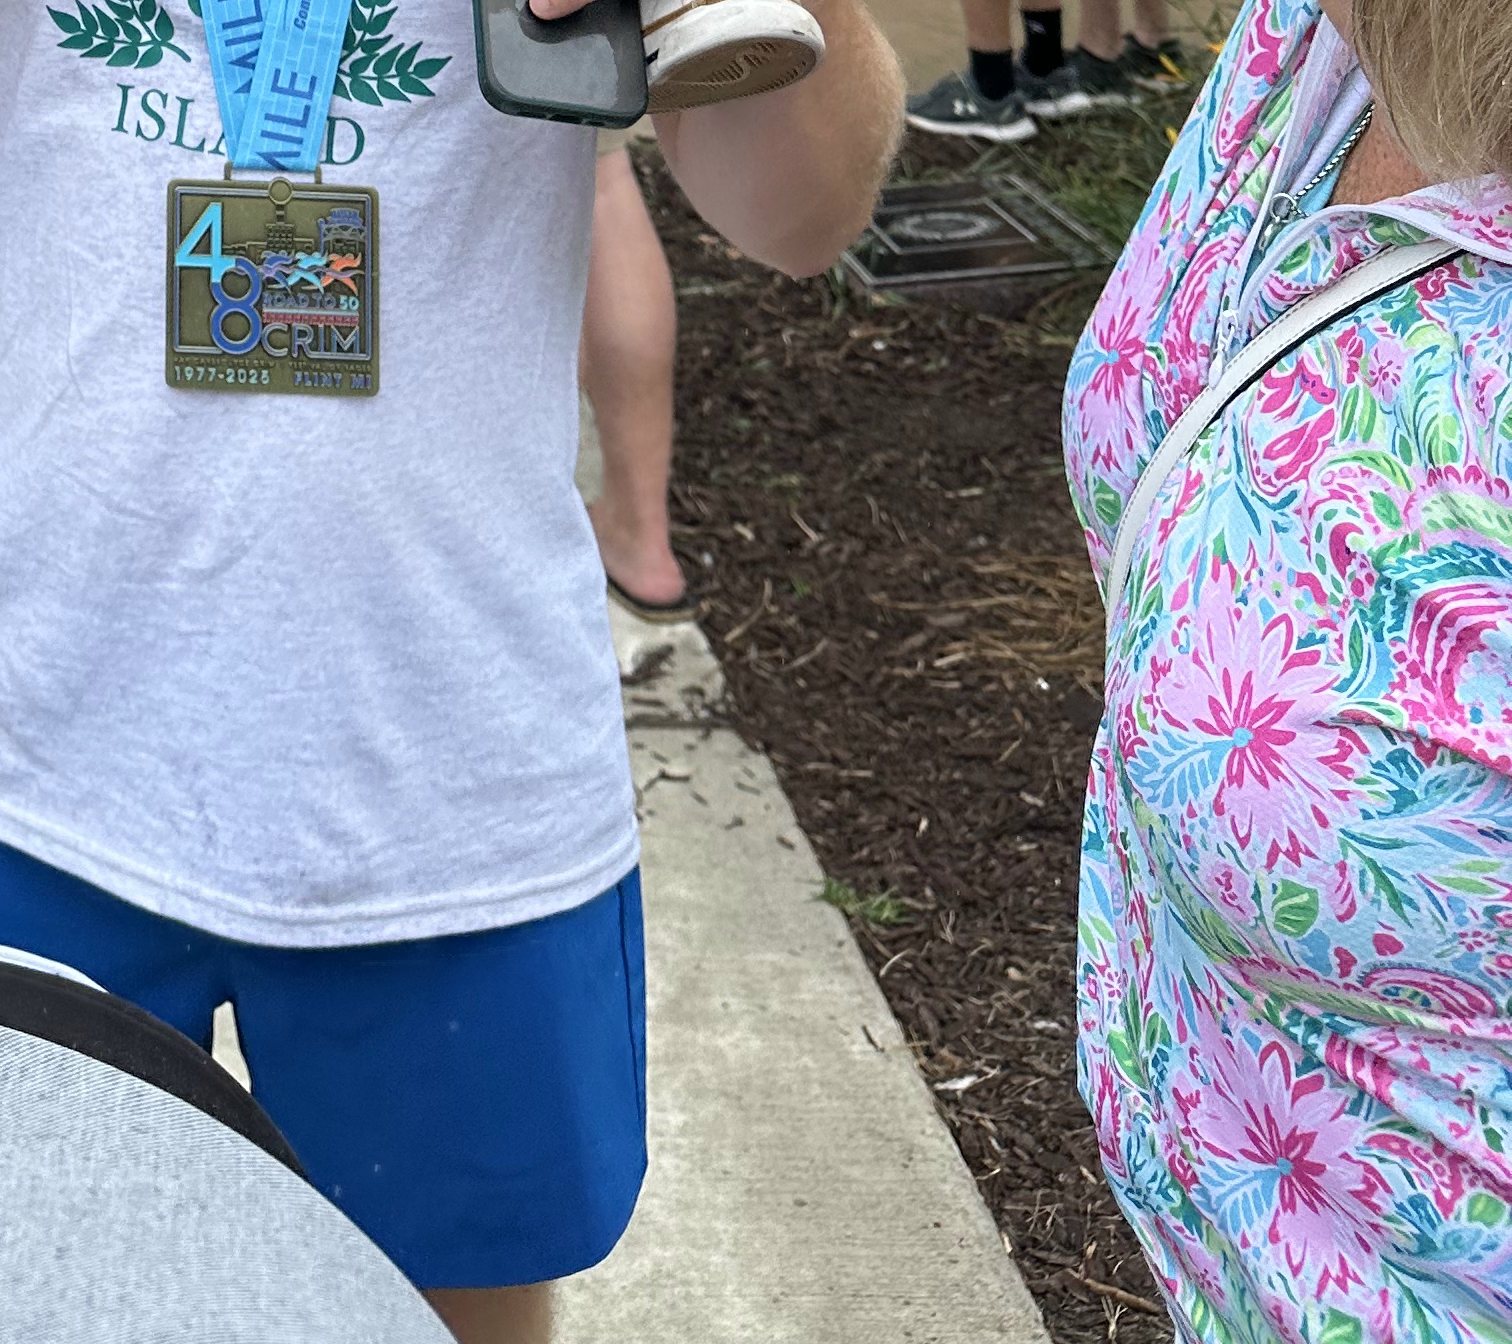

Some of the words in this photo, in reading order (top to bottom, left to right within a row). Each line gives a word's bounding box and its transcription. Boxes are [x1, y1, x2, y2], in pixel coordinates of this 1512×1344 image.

[110, 83, 366, 165] ISLD
[262, 292, 309, 308] ROAD
[312, 293, 337, 310] TO
[339, 295, 360, 311] 50
[261, 322, 360, 358] CRIM
[293, 370, 343, 388] FLINT
[349, 372, 373, 390] MI
